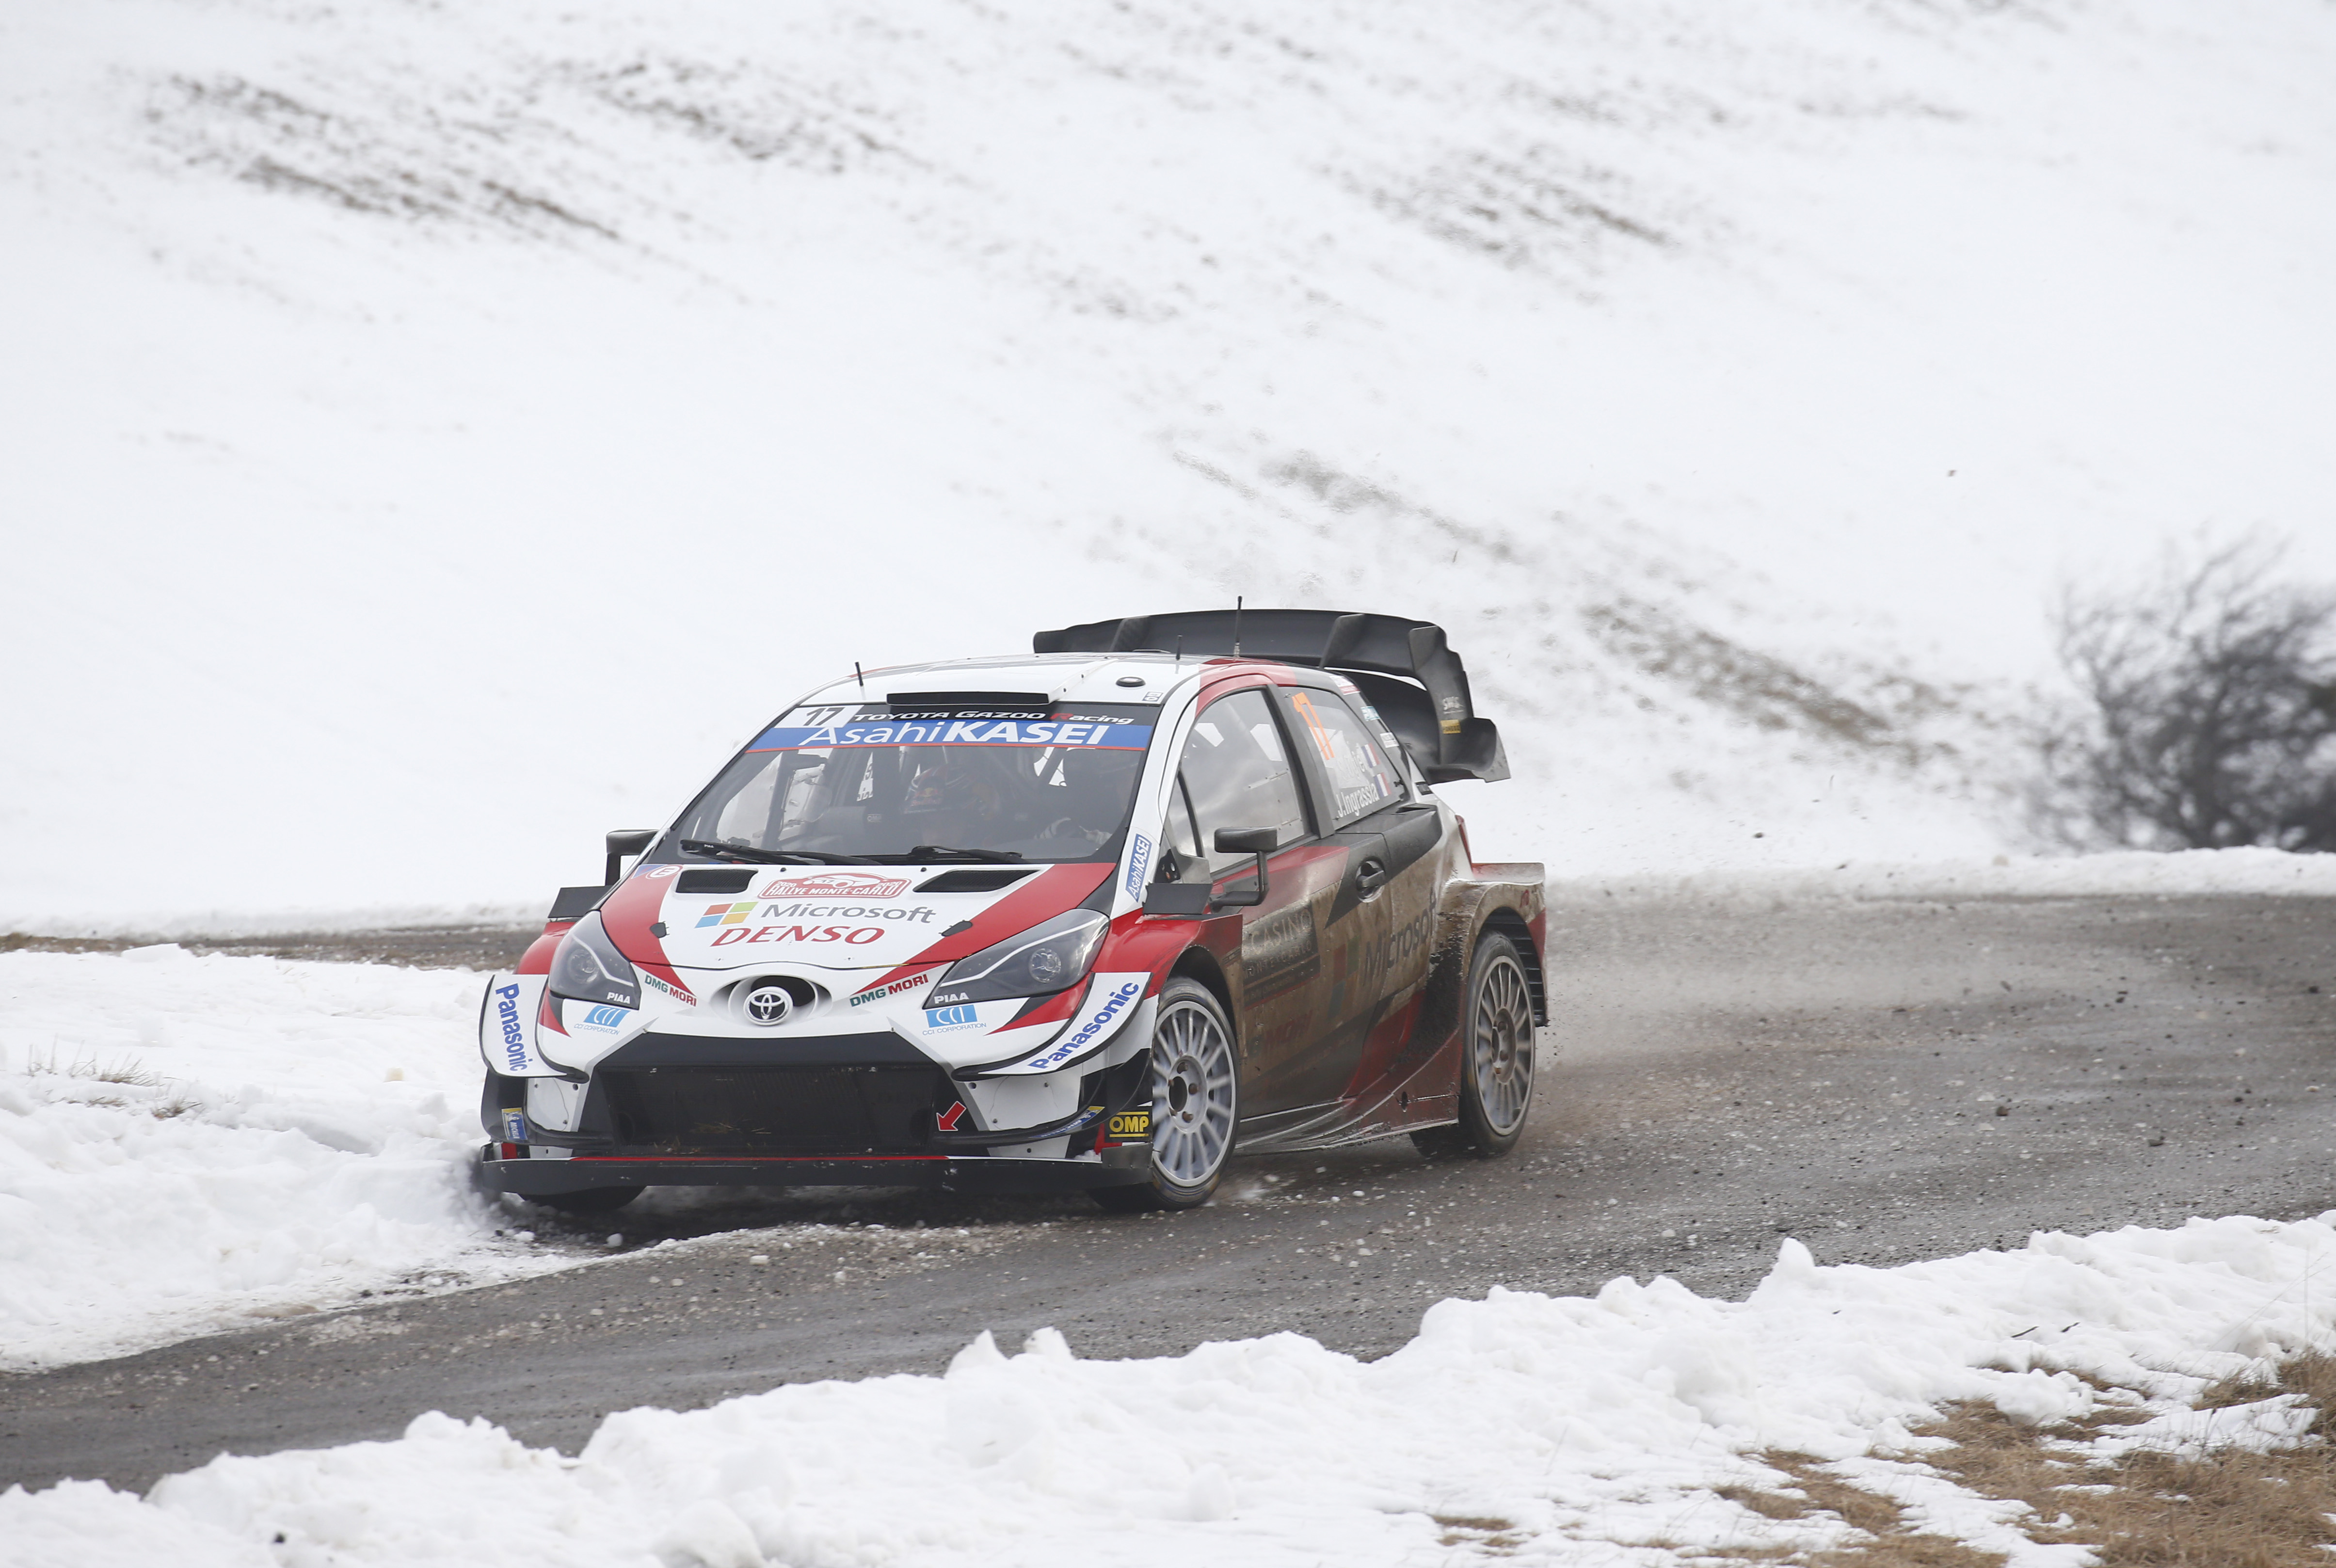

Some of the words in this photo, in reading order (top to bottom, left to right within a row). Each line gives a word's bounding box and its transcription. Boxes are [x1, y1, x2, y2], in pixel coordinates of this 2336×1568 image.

[802, 707, 846, 726] 17
[854, 712, 950, 721] TOYOTA
[955, 710, 1046, 719] GAZOO
[1049, 713, 1135, 725] Racing
[798, 721, 1110, 746] AsahiKASEI
[1336, 783, 1380, 818] J.Ingrassia
[1128, 836, 1150, 899] AsahiKASEI
[765, 886, 808, 896] RALLYE
[760, 903, 937, 924] Microsoft
[709, 925, 885, 947] DENSO
[606, 992, 631, 1005] PIAA
[644, 974, 668, 993] DMG
[668, 987, 697, 1007] MORI
[849, 988, 887, 1007] DMG
[888, 974, 929, 995] MORI
[934, 992, 970, 1004] PIAA
[495, 982, 533, 1072] Panasonic
[584, 1025, 620, 1036] CORPORATION
[937, 1023, 987, 1034] CORPORATION
[1028, 982, 1139, 1069] Panasonic
[1109, 1116, 1150, 1133] OMP
